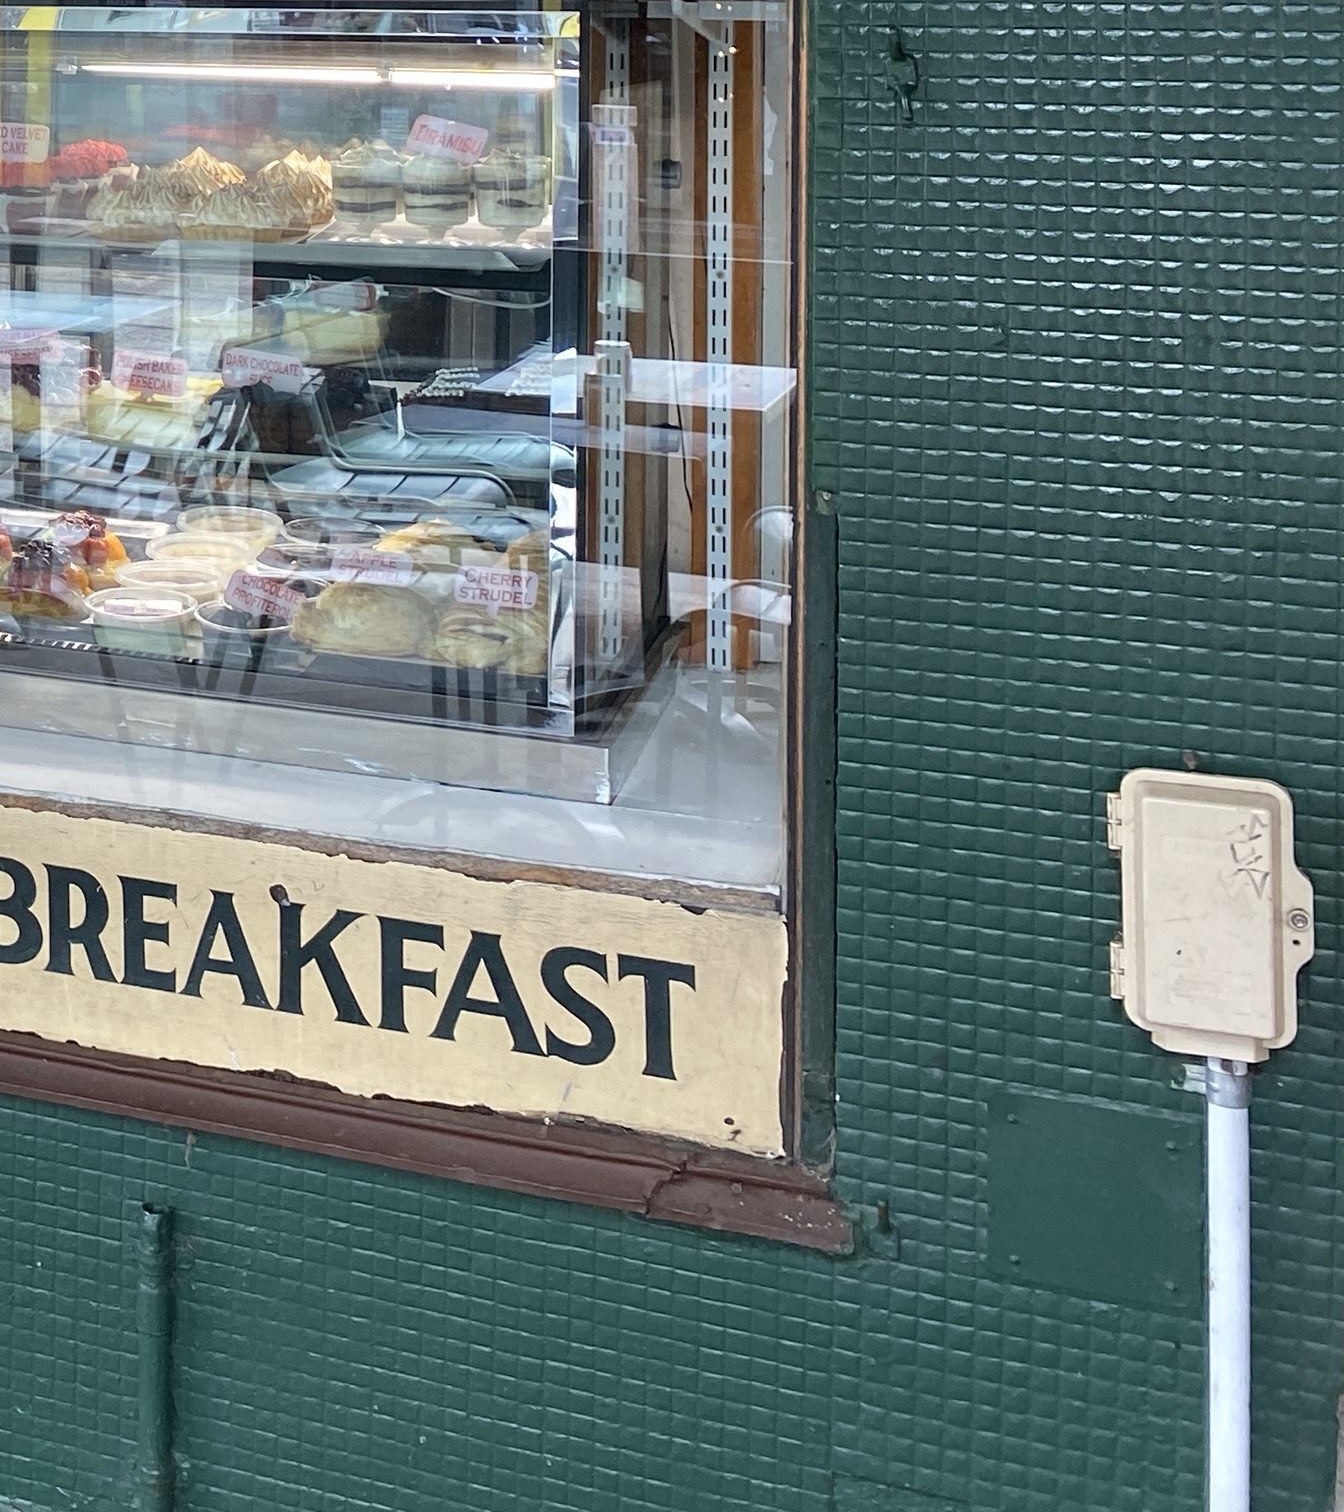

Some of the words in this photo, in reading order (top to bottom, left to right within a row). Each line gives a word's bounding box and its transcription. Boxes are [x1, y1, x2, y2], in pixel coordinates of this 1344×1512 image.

[11, 125, 48, 140] VELVET
[414, 121, 485, 157] TIRAMISU
[1, 140, 30, 155] CAKE
[152, 360, 184, 376] BAKED
[225, 352, 249, 368] DARK
[250, 357, 300, 377] CHOCOLATE
[349, 549, 398, 568] APPLE
[338, 563, 404, 584] STRUDEL
[464, 567, 534, 587] CHERRY
[241, 573, 303, 605] CHOCOLATE
[459, 587, 533, 606] STRUDEL
